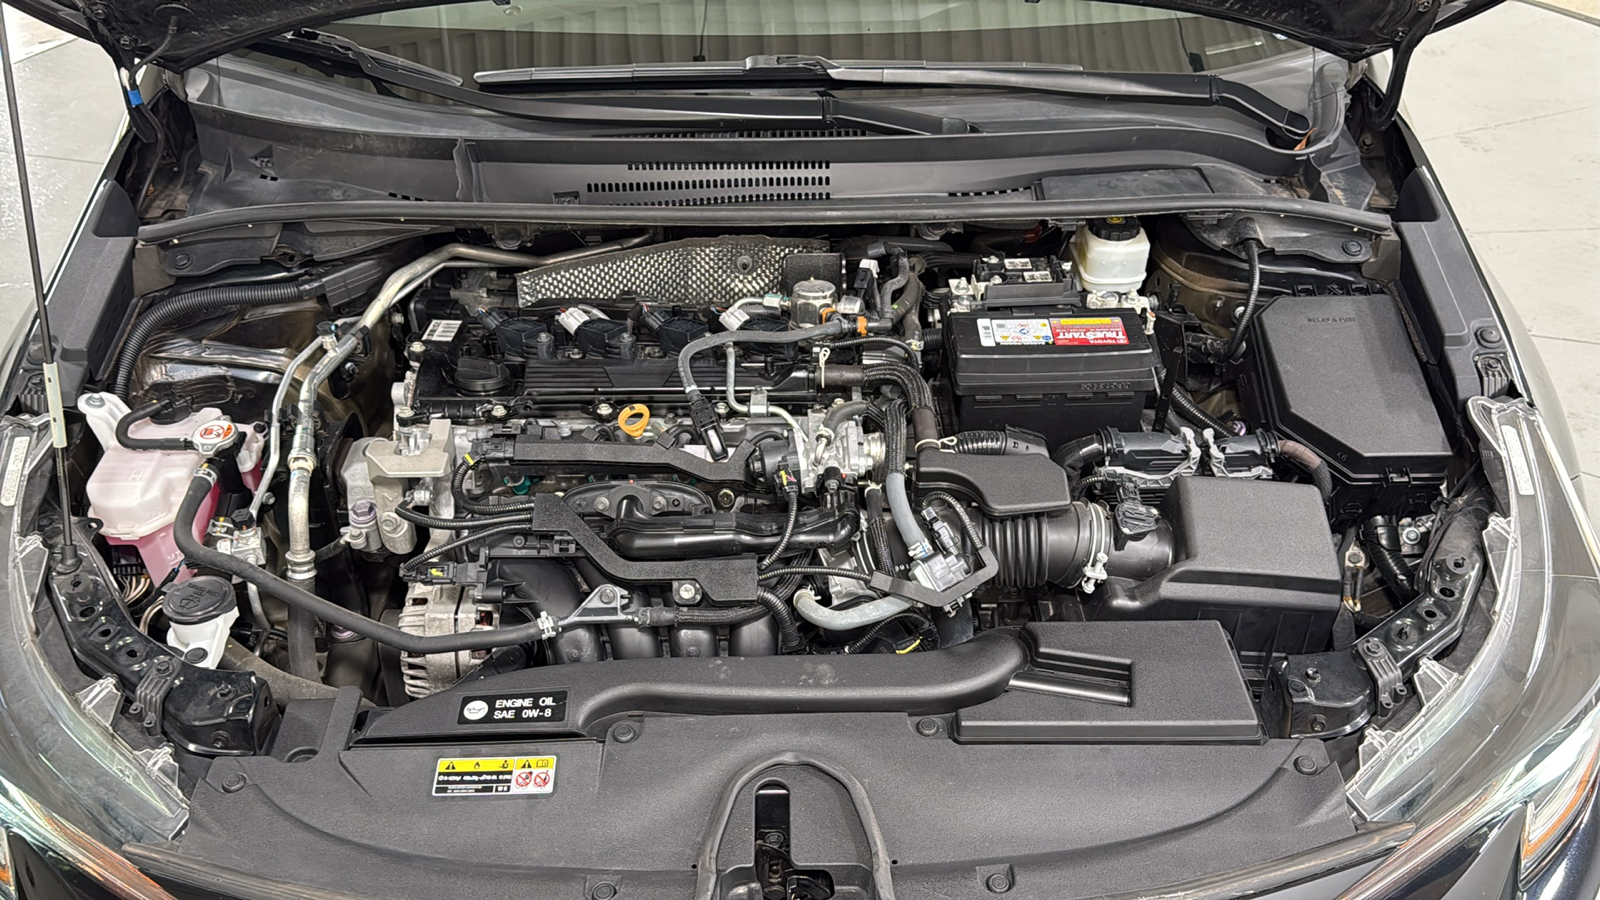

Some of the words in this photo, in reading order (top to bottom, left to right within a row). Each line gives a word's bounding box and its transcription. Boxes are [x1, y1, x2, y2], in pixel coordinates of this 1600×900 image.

[495, 698, 533, 708] ENGINE
[539, 697, 556, 706] OIL
[493, 710, 516, 720] SAE
